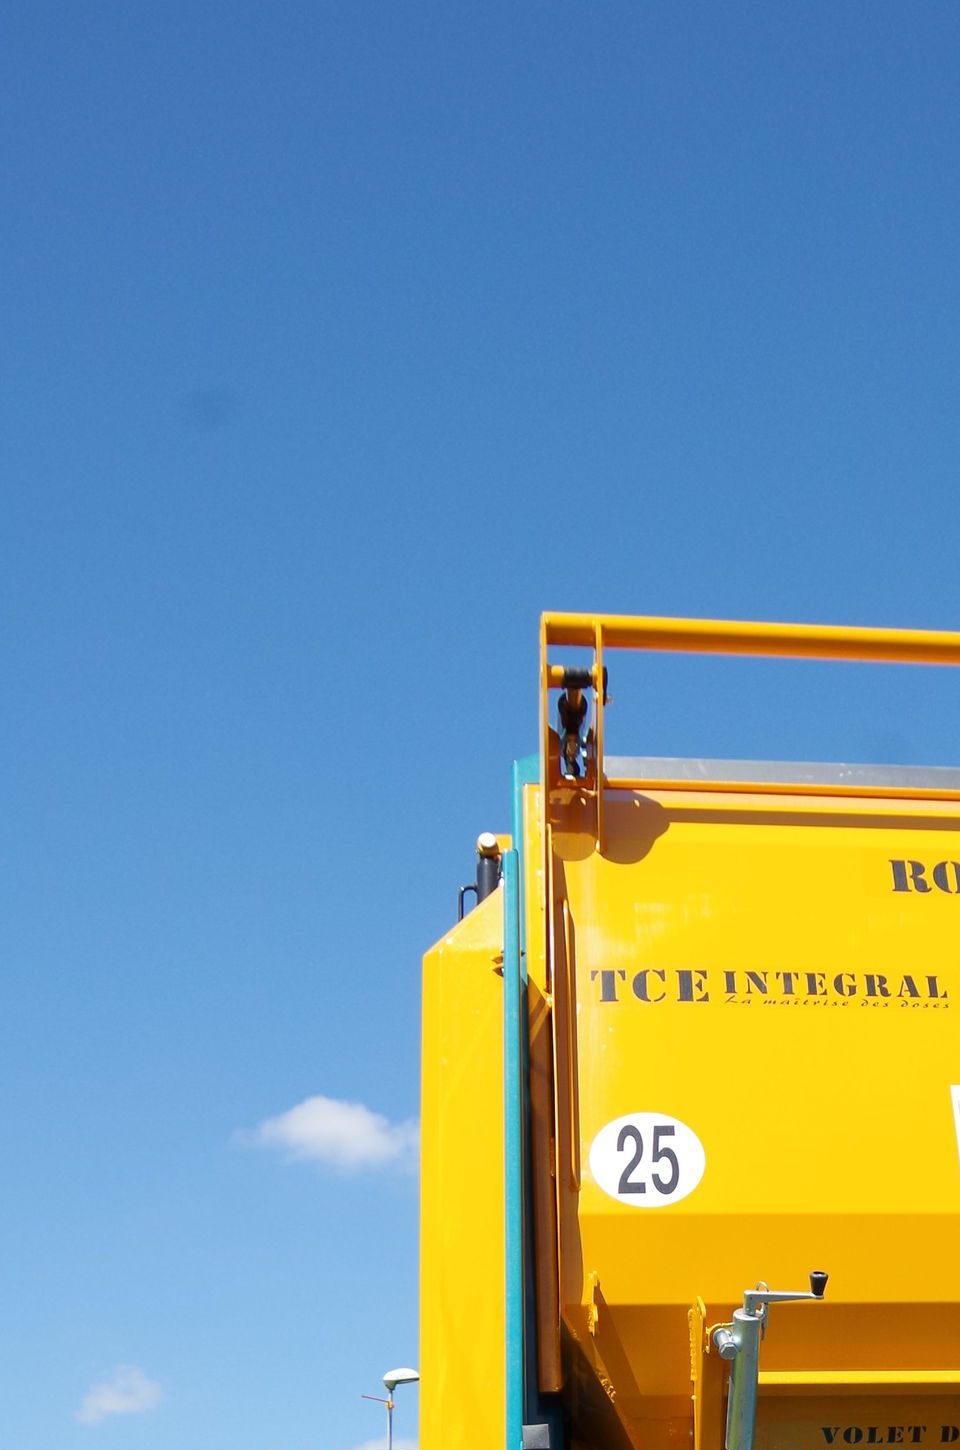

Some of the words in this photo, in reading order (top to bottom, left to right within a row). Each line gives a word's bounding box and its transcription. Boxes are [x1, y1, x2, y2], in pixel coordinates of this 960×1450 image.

[590, 969, 709, 1003] TCE
[723, 970, 949, 999] INTEGRAL
[860, 997, 889, 1008] des
[900, 998, 950, 1009] doses
[616, 1125, 680, 1195] 25
[821, 1426, 928, 1445] VOLET
